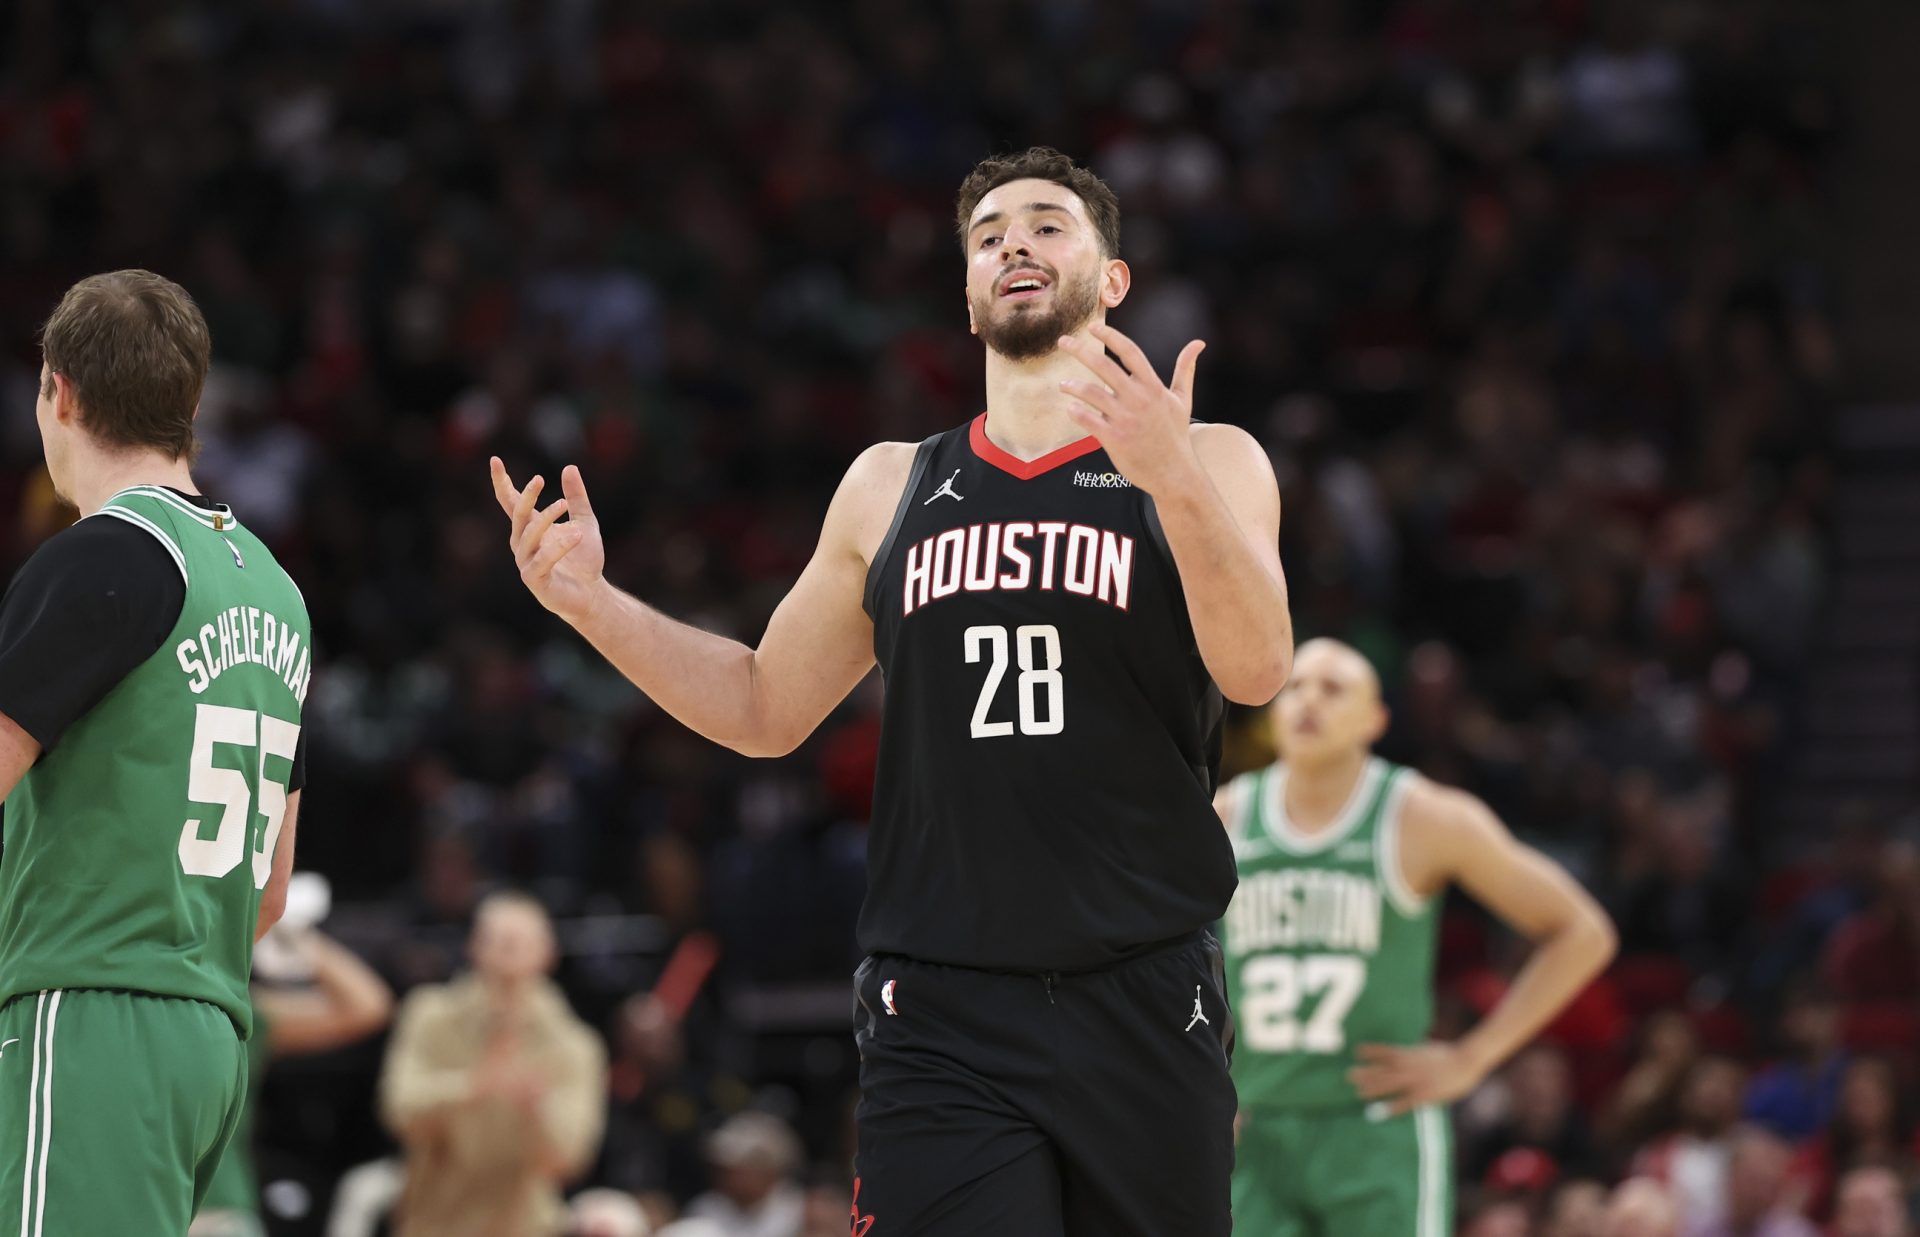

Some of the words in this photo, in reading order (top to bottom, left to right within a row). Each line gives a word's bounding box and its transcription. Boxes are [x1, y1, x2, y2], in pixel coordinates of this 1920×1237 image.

[903, 521, 1136, 618] HOUSTON
[963, 624, 1065, 739] 28
[178, 703, 301, 890] 55
[1240, 952, 1368, 1054] 27
